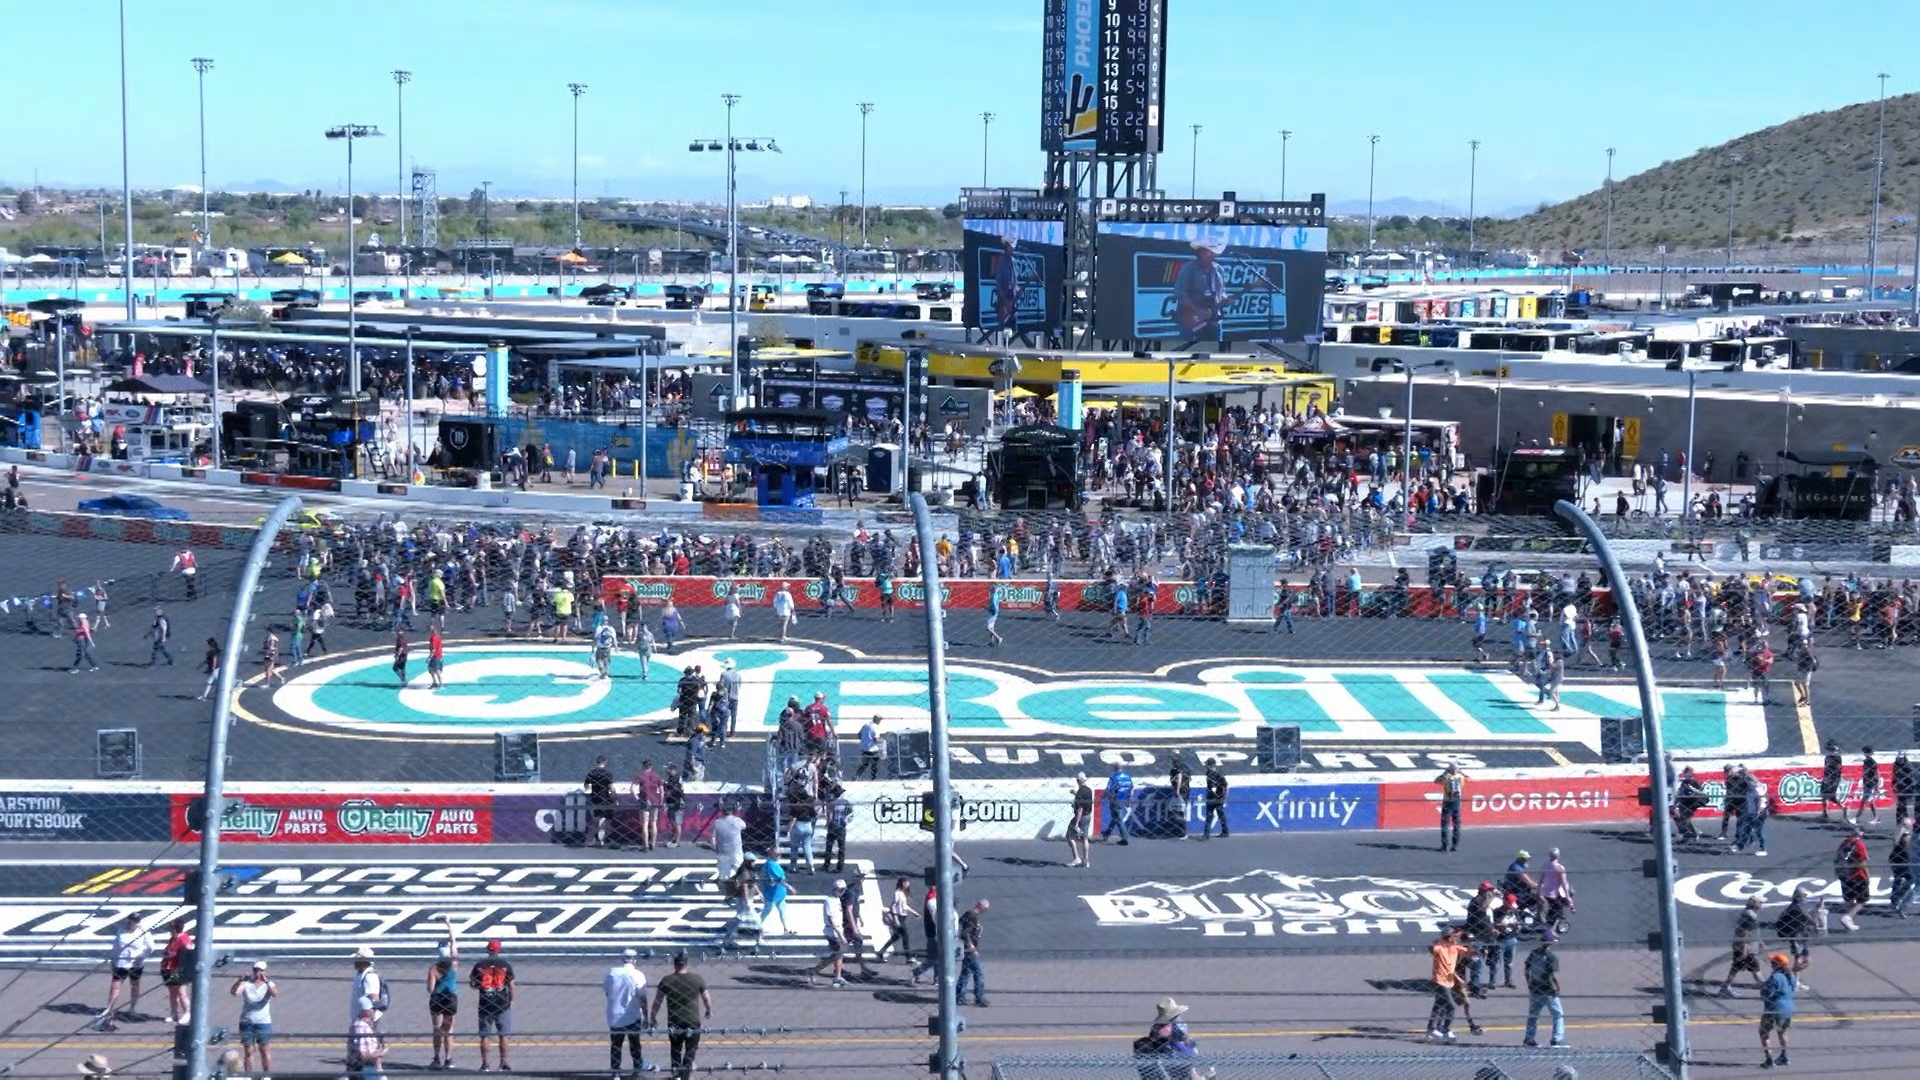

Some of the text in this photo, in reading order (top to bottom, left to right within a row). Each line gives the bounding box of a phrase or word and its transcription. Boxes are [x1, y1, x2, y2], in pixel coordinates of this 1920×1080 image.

[1105, 13, 1120, 27] 10
[1104, 29, 1120, 43] 11
[1104, 46, 1119, 60] 12
[1103, 63, 1119, 77] 13
[1103, 79, 1119, 93] 14
[1102, 95, 1118, 110] 15
[1105, 111, 1119, 126] 16
[1105, 128, 1119, 141] 17
[1196, 750, 1487, 769] PRTS
[0, 797, 62, 811] ARSTOOL
[1256, 788, 1360, 828] xfinity
[1471, 789, 1609, 813] DOORDASH
[288, 809, 323, 822] AUTO
[339, 799, 433, 837] O'Reilly
[440, 809, 475, 822] AUTO
[535, 793, 587, 833] all
[0, 813, 86, 829] PORTSBOOK
[284, 823, 328, 835] PARTS
[436, 823, 478, 835] PARTS
[1201, 918, 1451, 937] LIGHT
